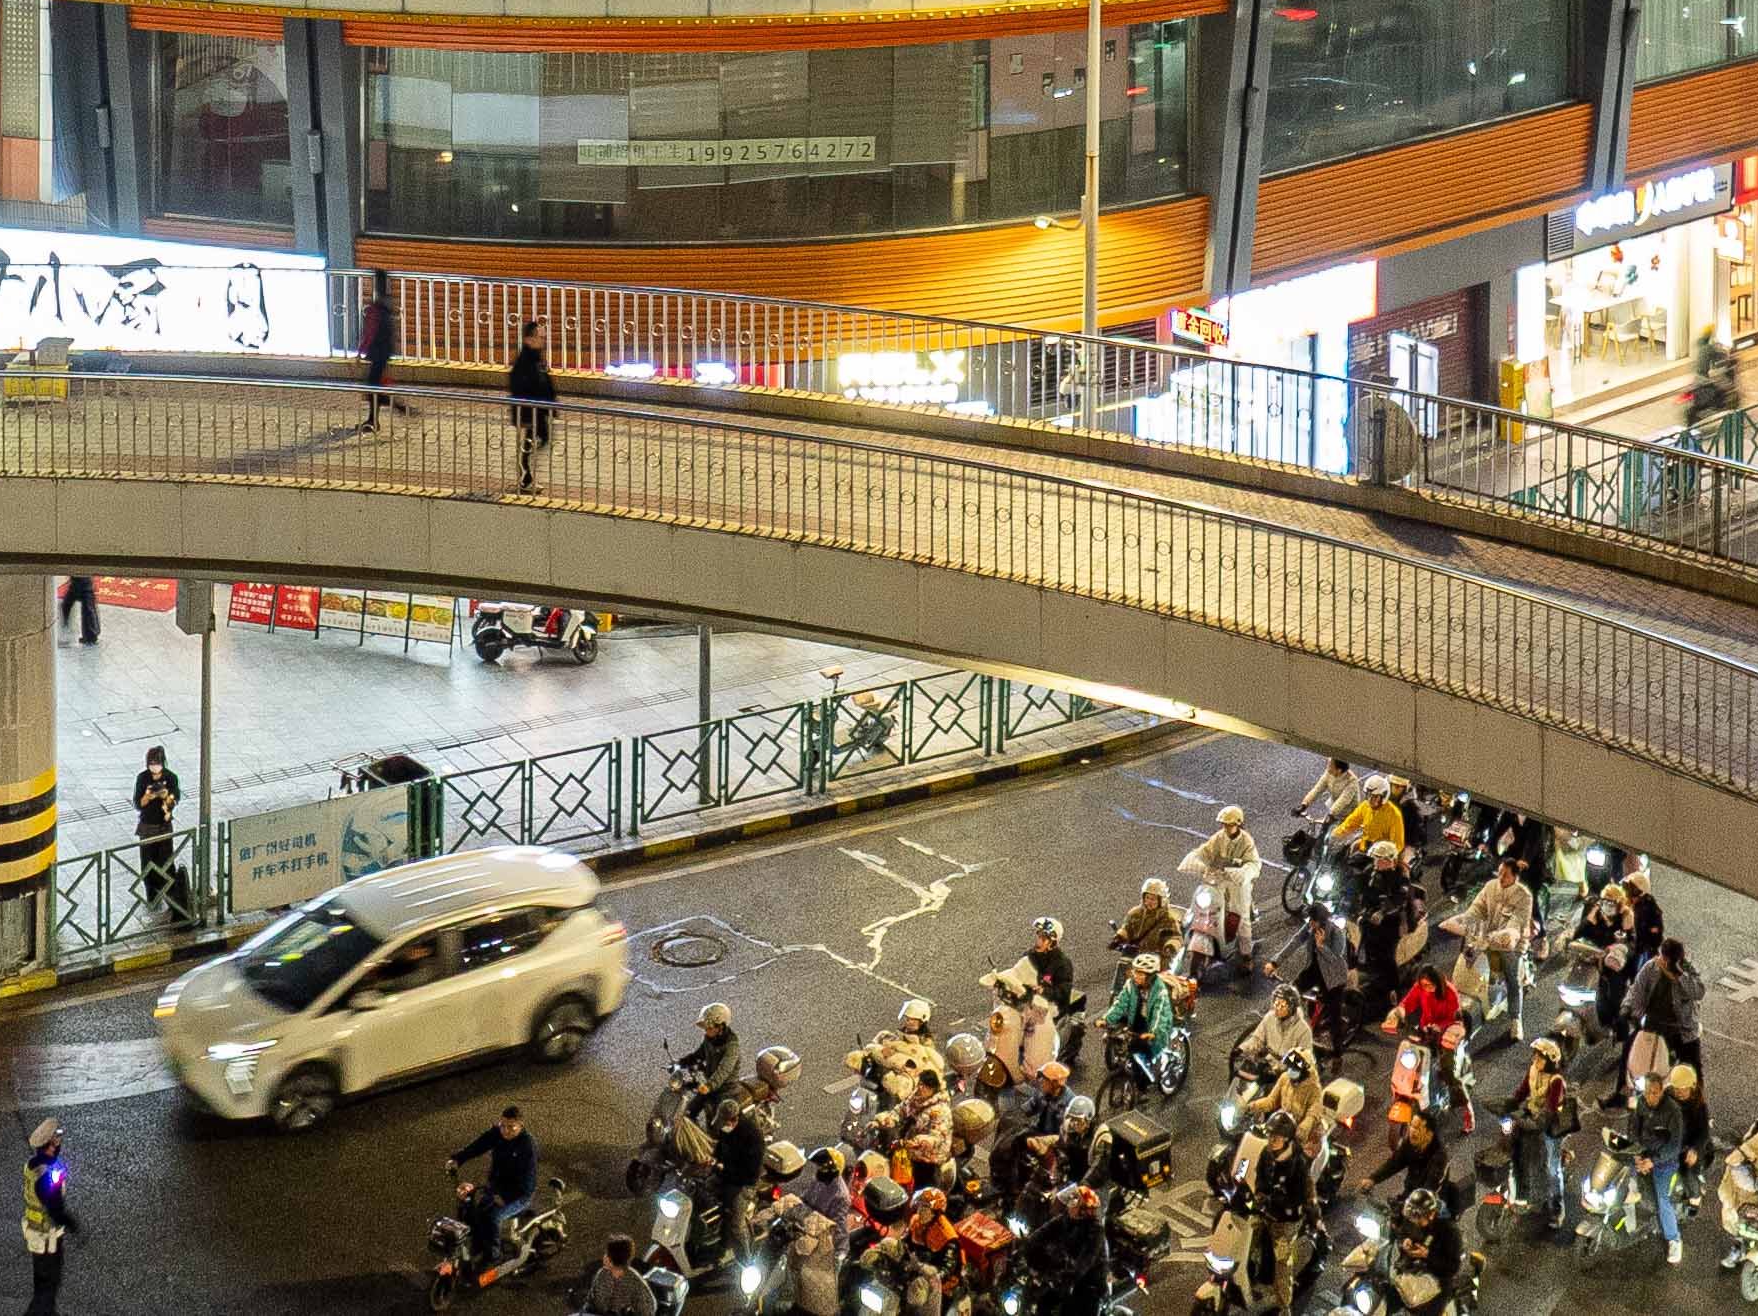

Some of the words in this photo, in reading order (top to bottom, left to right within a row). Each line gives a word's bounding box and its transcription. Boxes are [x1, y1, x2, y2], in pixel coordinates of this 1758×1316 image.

[686, 141, 873, 163] 19925764272
[251, 851, 329, 881] 开车不打手机
